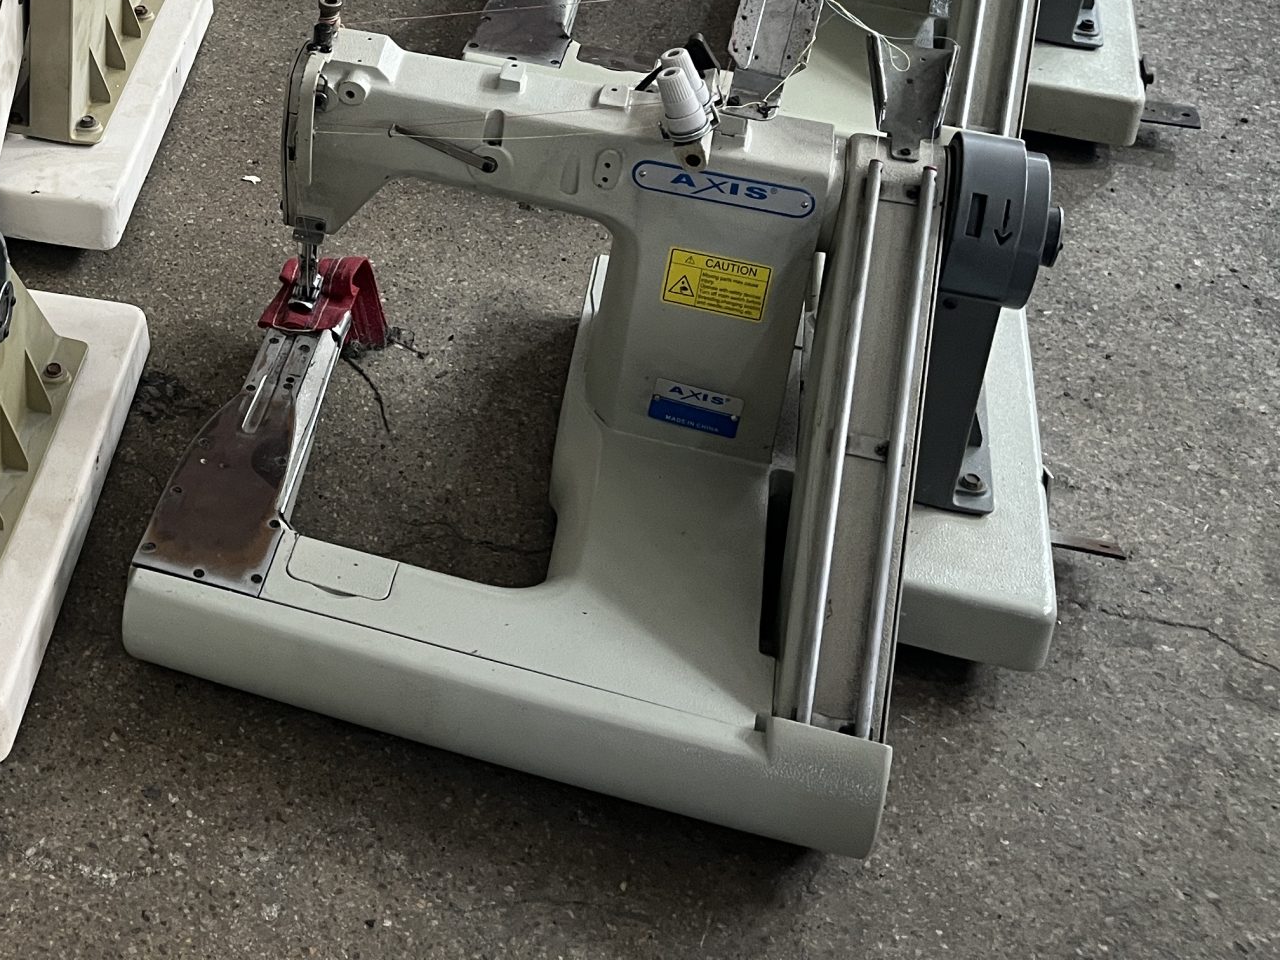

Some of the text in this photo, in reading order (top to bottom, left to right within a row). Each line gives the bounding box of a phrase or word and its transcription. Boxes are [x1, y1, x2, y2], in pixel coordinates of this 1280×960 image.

[670, 173, 768, 200] AXIS
[705, 258, 757, 277] CAUTION
[669, 385, 724, 405] AXIS
[665, 414, 686, 424] MADE
[696, 422, 719, 433] CHINA
